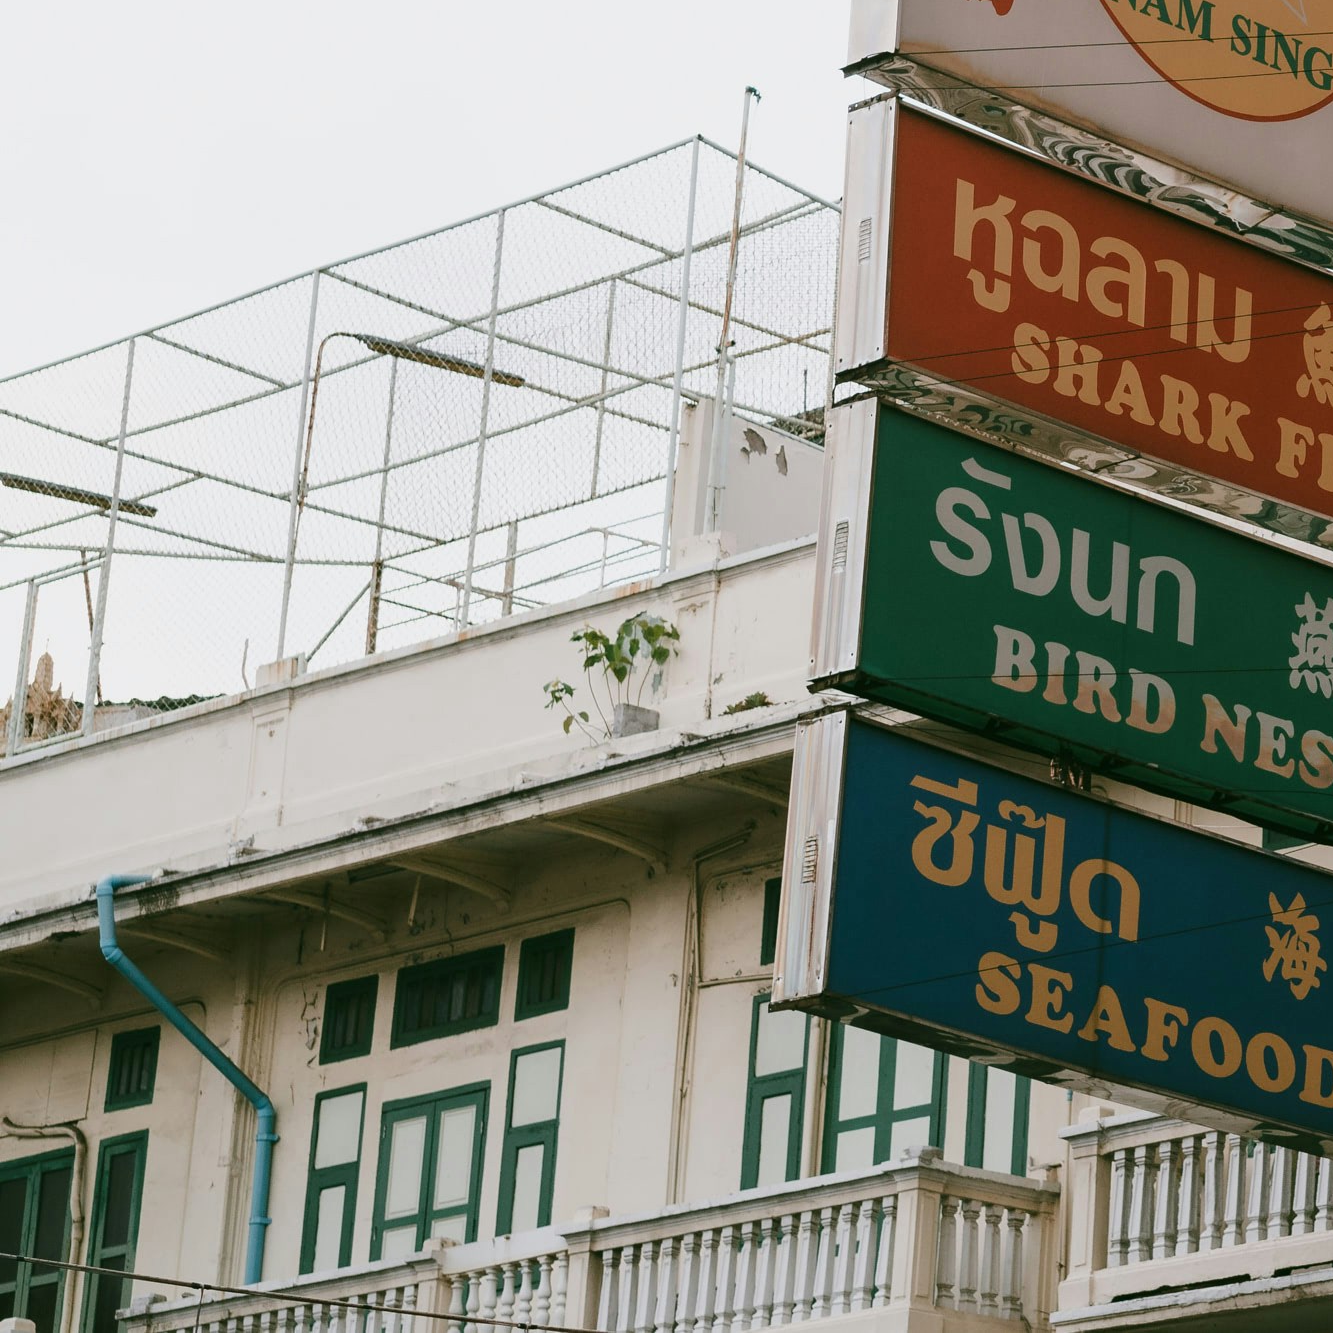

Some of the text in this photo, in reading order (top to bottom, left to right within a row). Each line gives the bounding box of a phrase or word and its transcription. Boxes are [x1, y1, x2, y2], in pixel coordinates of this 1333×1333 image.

[953, 178, 1253, 364] หูฉลาม
[1011, 322, 1254, 462] SHARK
[929, 457, 1197, 646] รังนก
[991, 624, 1177, 735] BIRD
